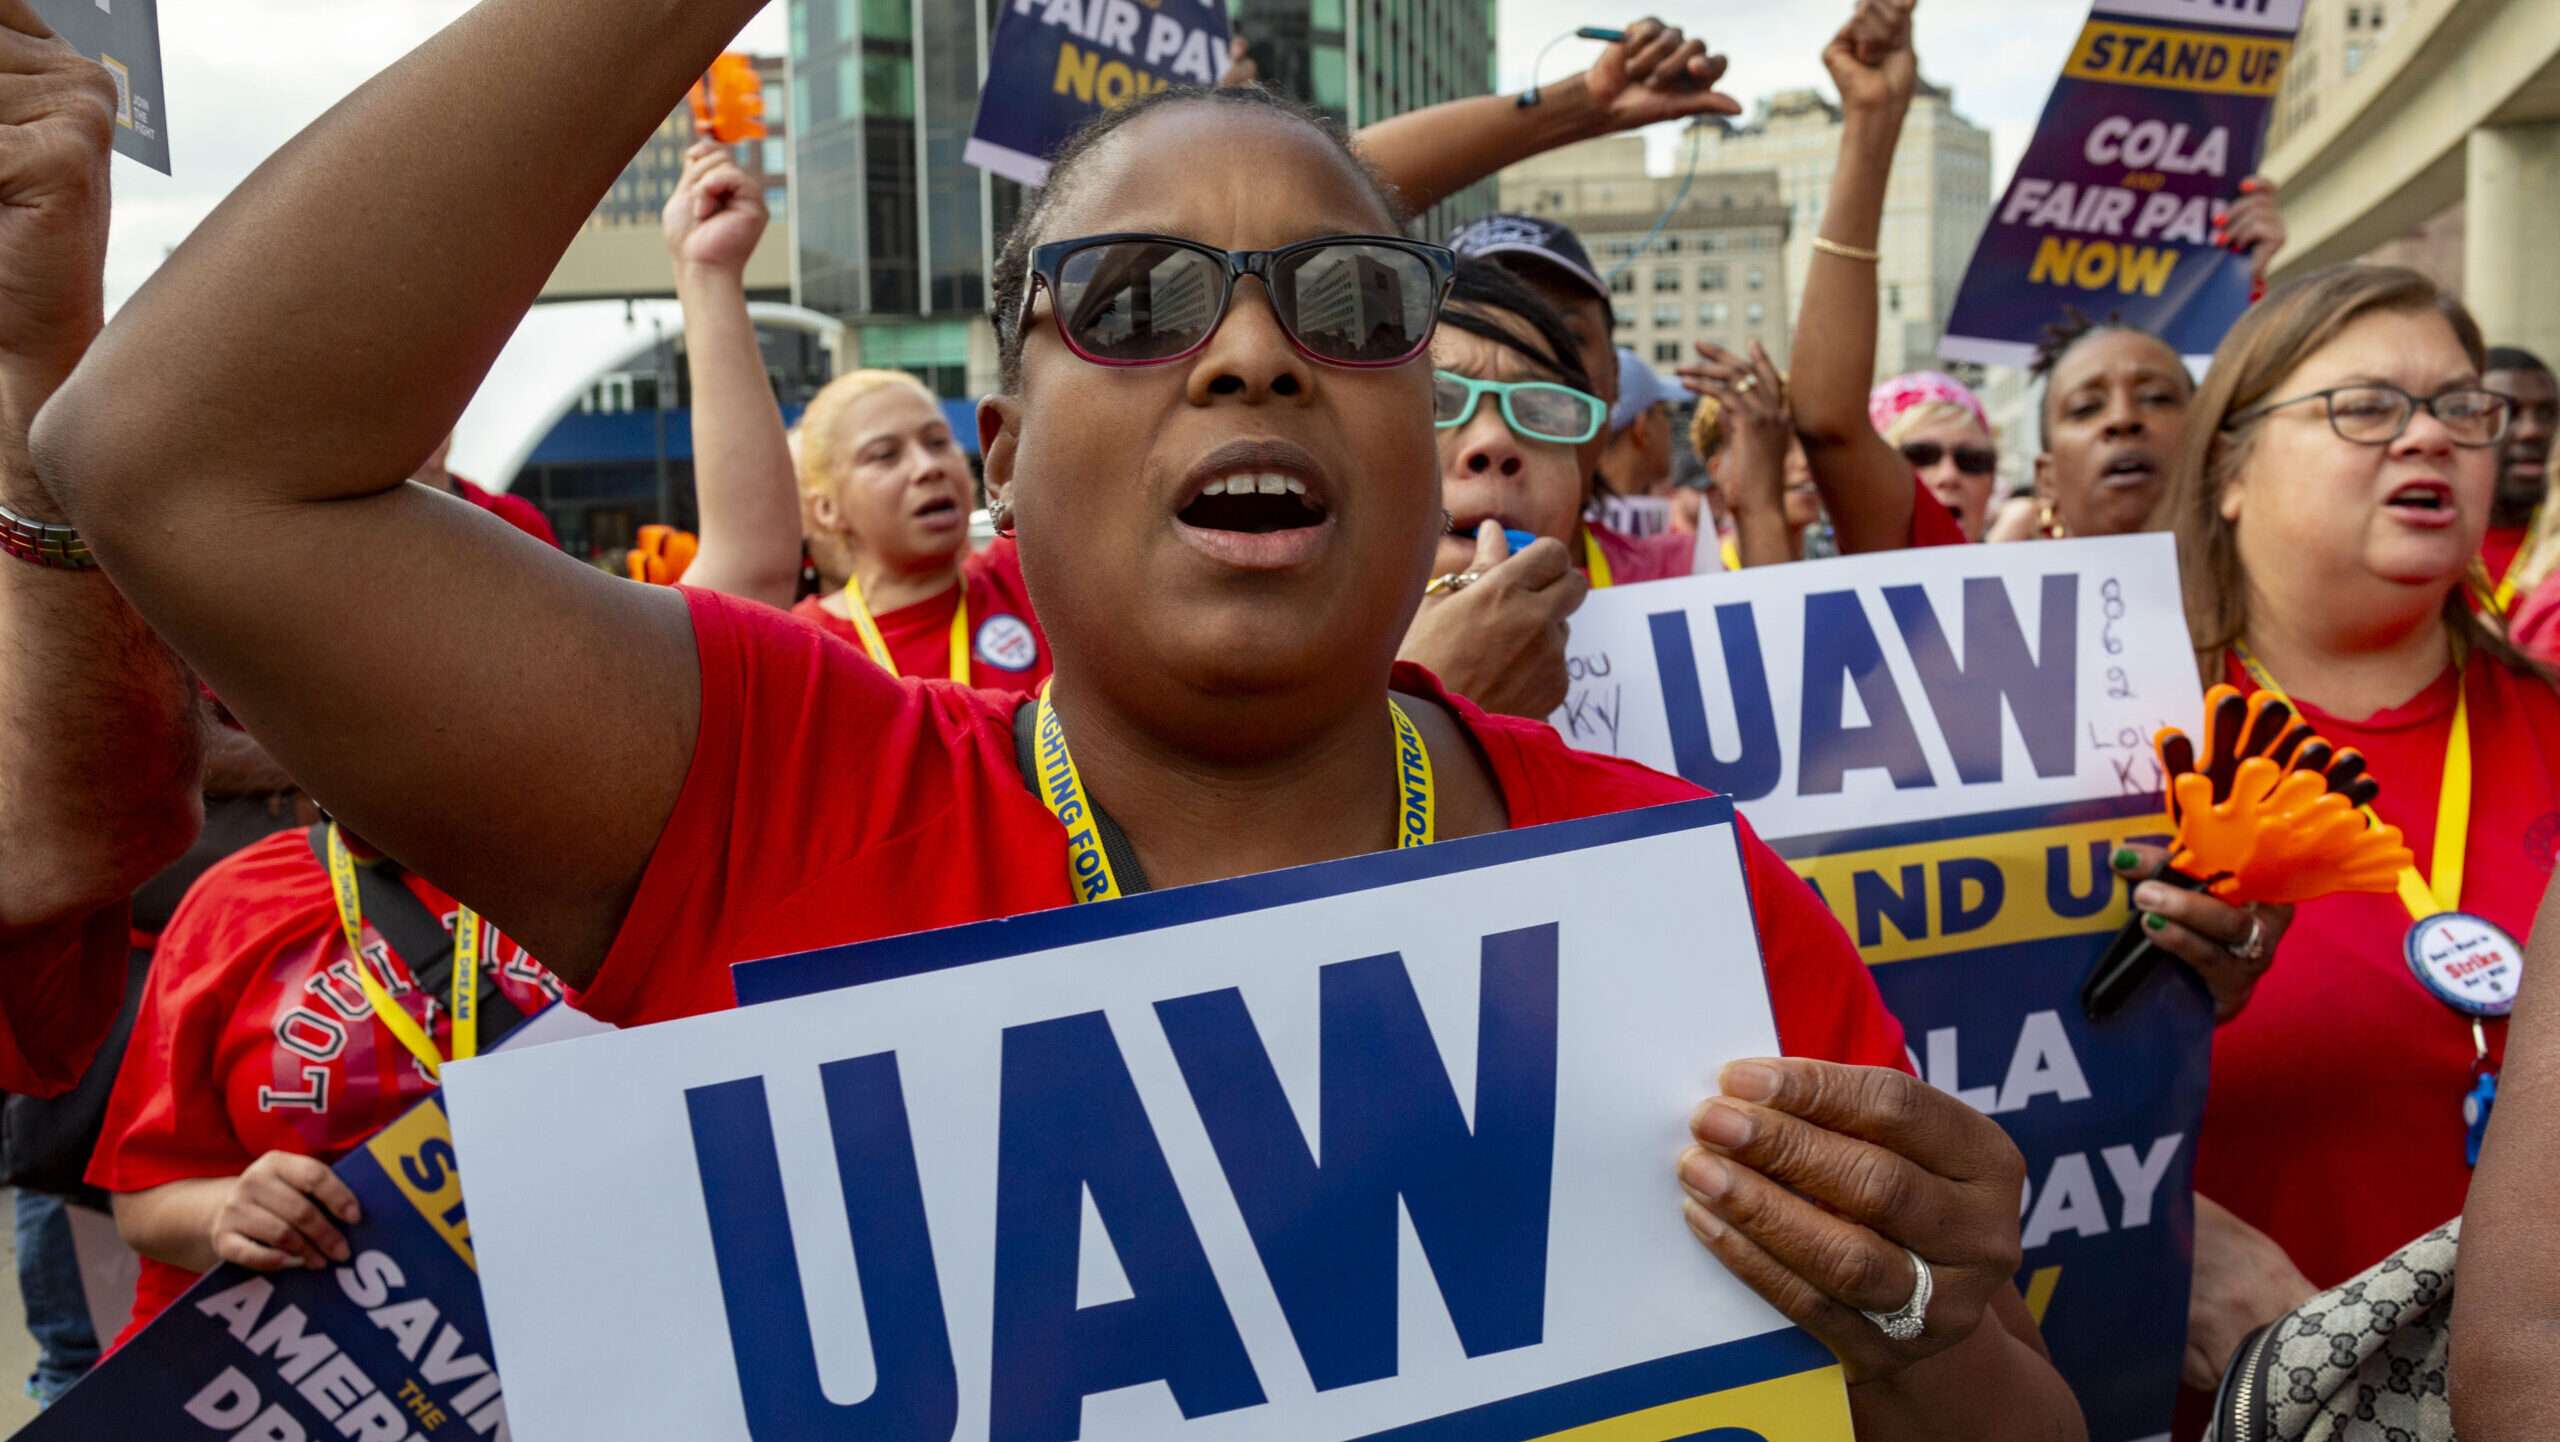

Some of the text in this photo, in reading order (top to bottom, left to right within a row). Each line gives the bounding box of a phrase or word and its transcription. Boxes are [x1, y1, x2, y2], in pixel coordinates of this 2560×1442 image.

[2084, 34, 2281, 85] STAND UP
[2084, 116, 2229, 176] COLA
[2000, 178, 2136, 235] FAIR
[2028, 236, 2180, 297] NOW
[1566, 651, 1611, 681] OU
[1647, 573, 2079, 801] UAW
[1069, 828, 1110, 902] FOR
[2444, 951, 2504, 979] Strike
[684, 921, 1559, 1442] UAW
[2020, 1132, 2184, 1250] AY
[195, 1276, 429, 1442] AMER
[335, 1250, 510, 1442] SAVIN
[397, 1378, 447, 1431] THE
